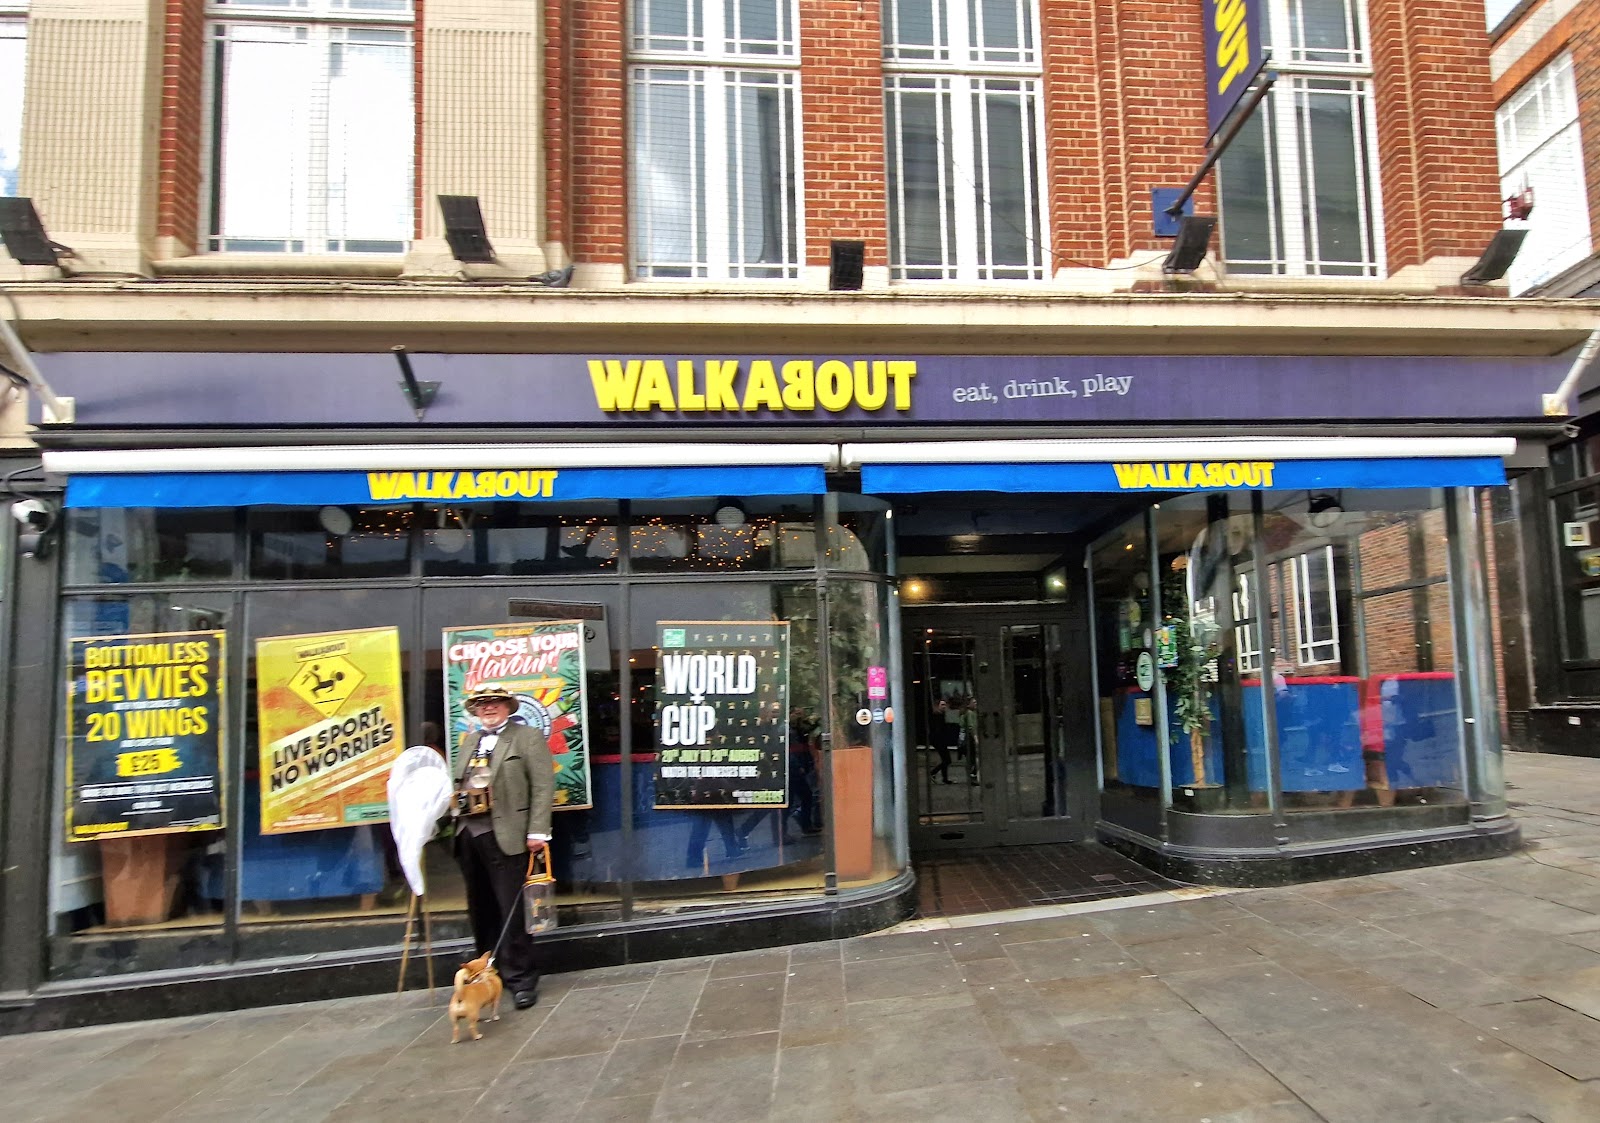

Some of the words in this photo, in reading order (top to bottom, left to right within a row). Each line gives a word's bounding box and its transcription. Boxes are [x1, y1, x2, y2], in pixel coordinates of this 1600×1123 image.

[587, 360, 917, 412] WALKABOUT
[952, 384, 998, 405] eat,
[1003, 377, 1078, 402] drink,
[1083, 373, 1134, 399] play
[367, 471, 559, 499] WALKABOUT
[1113, 463, 1274, 488] WALKABOUT
[85, 641, 210, 668] BOTTOMLESS
[449, 637, 528, 662] CHOOSE
[530, 632, 579, 653] YOUR
[85, 664, 209, 703] BEVVIES
[663, 655, 757, 696] WORLD
[86, 712, 121, 742] 20
[125, 706, 209, 739] WINGS
[274, 736, 312, 769] LIVE
[317, 706, 385, 750] SPORT,
[662, 705, 716, 745] CUP
[270, 765, 299, 792] NO
[305, 723, 394, 776] WORRIES
